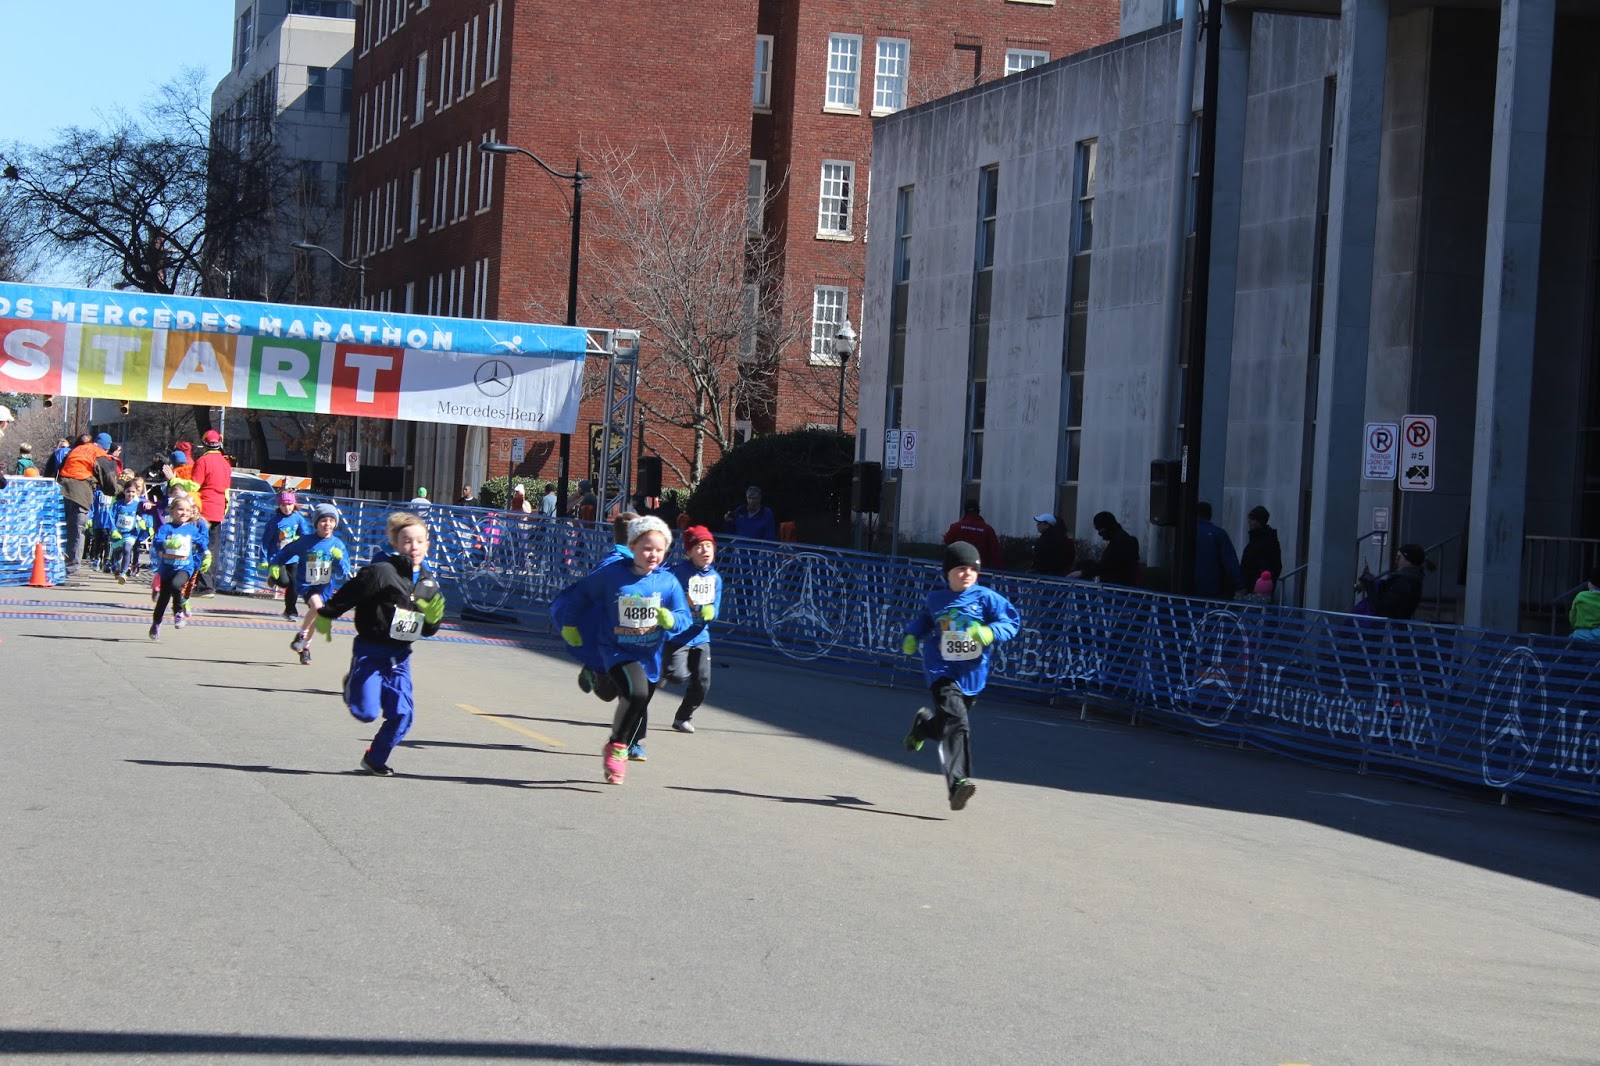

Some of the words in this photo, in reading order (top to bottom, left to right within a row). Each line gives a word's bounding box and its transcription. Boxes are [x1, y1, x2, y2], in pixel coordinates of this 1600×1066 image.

[51, 300, 242, 334] MERCEDES
[258, 316, 453, 350] MARATHON
[0, 328, 394, 404] START
[437, 401, 545, 422] Mercedes-Benz
[1411, 452, 1424, 460] #5
[623, 607, 656, 620] 4886
[1251, 662, 1431, 745] Mercedes-Benz
